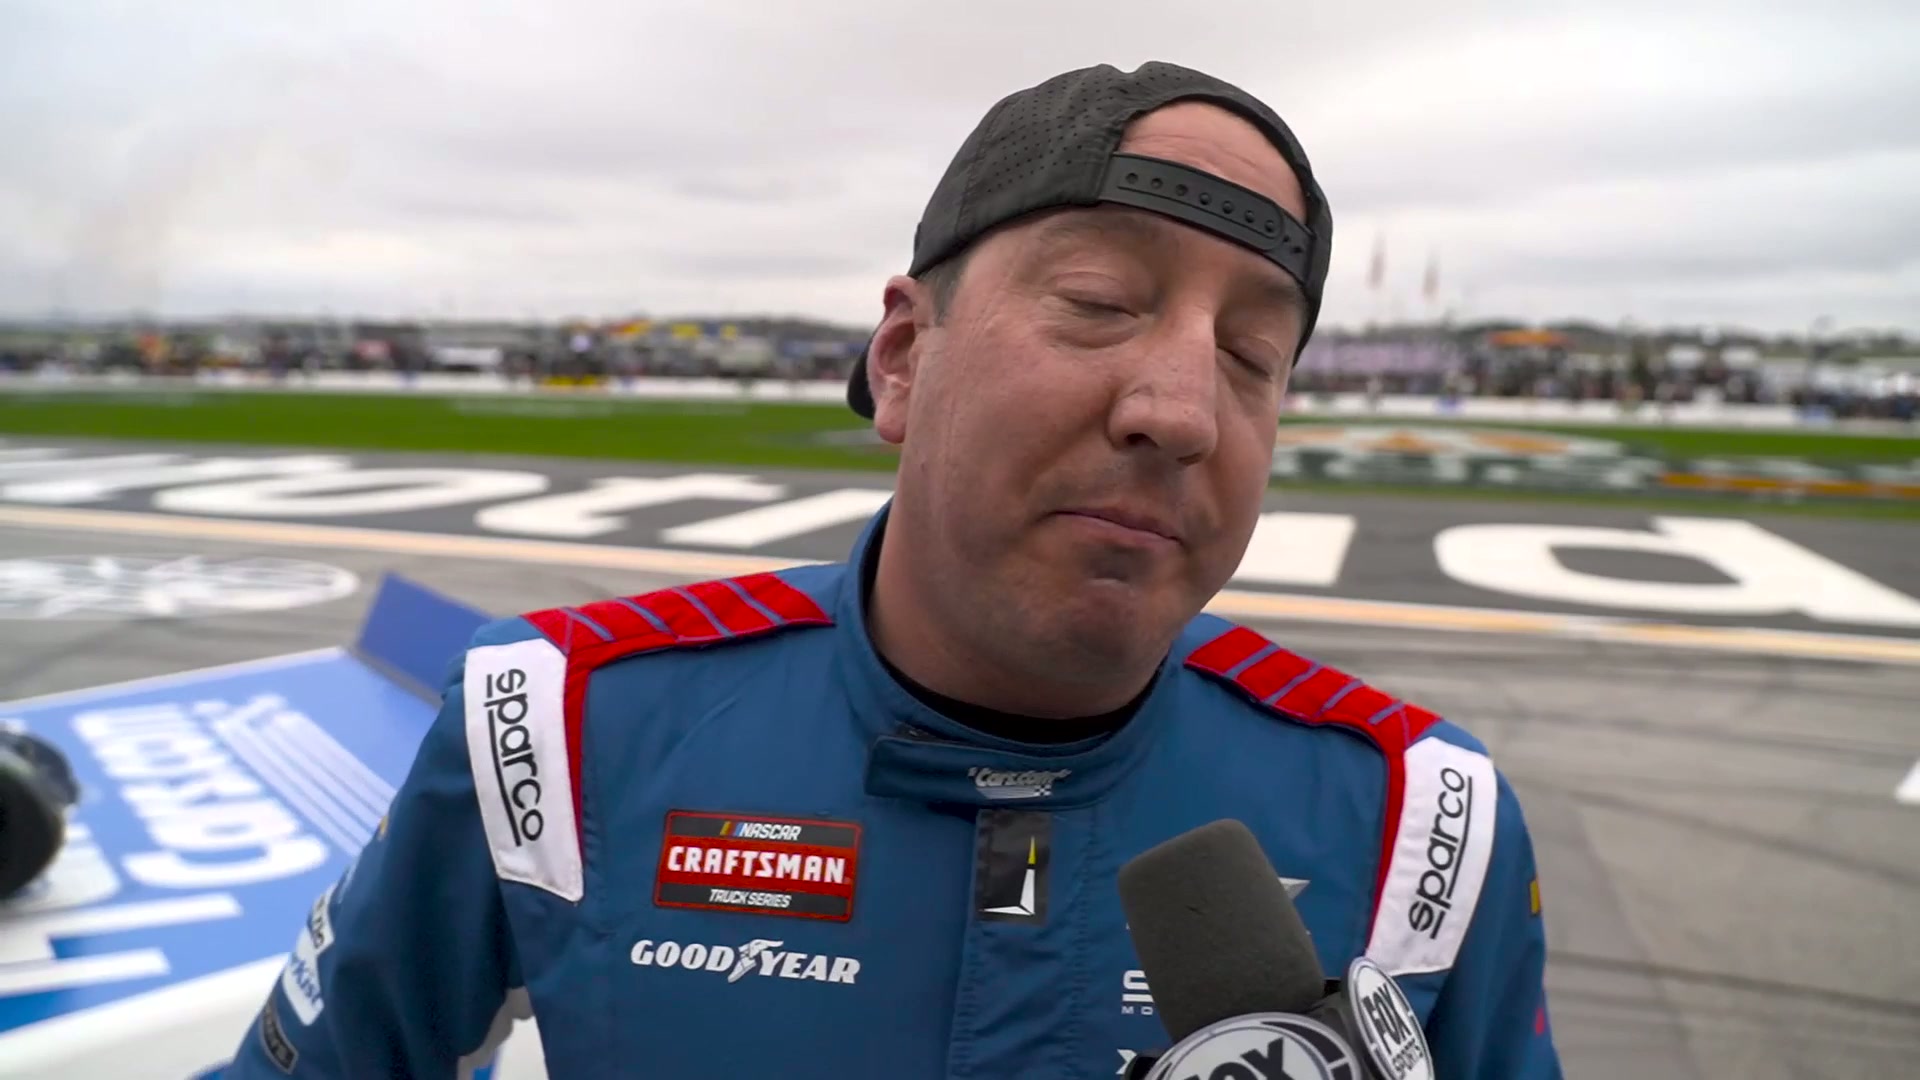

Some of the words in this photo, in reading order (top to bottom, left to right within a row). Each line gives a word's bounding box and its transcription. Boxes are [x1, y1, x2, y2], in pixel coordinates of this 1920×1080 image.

[485, 667, 545, 845] sparco
[738, 822, 803, 841] NASCAR
[1408, 766, 1471, 937] sparco
[667, 845, 847, 885] CRAFTSMAN
[709, 888, 750, 906] TRUCK
[749, 890, 793, 909] SERIES
[1361, 983, 1413, 1056] FOX
[1392, 1038, 1424, 1080] SPORTS
